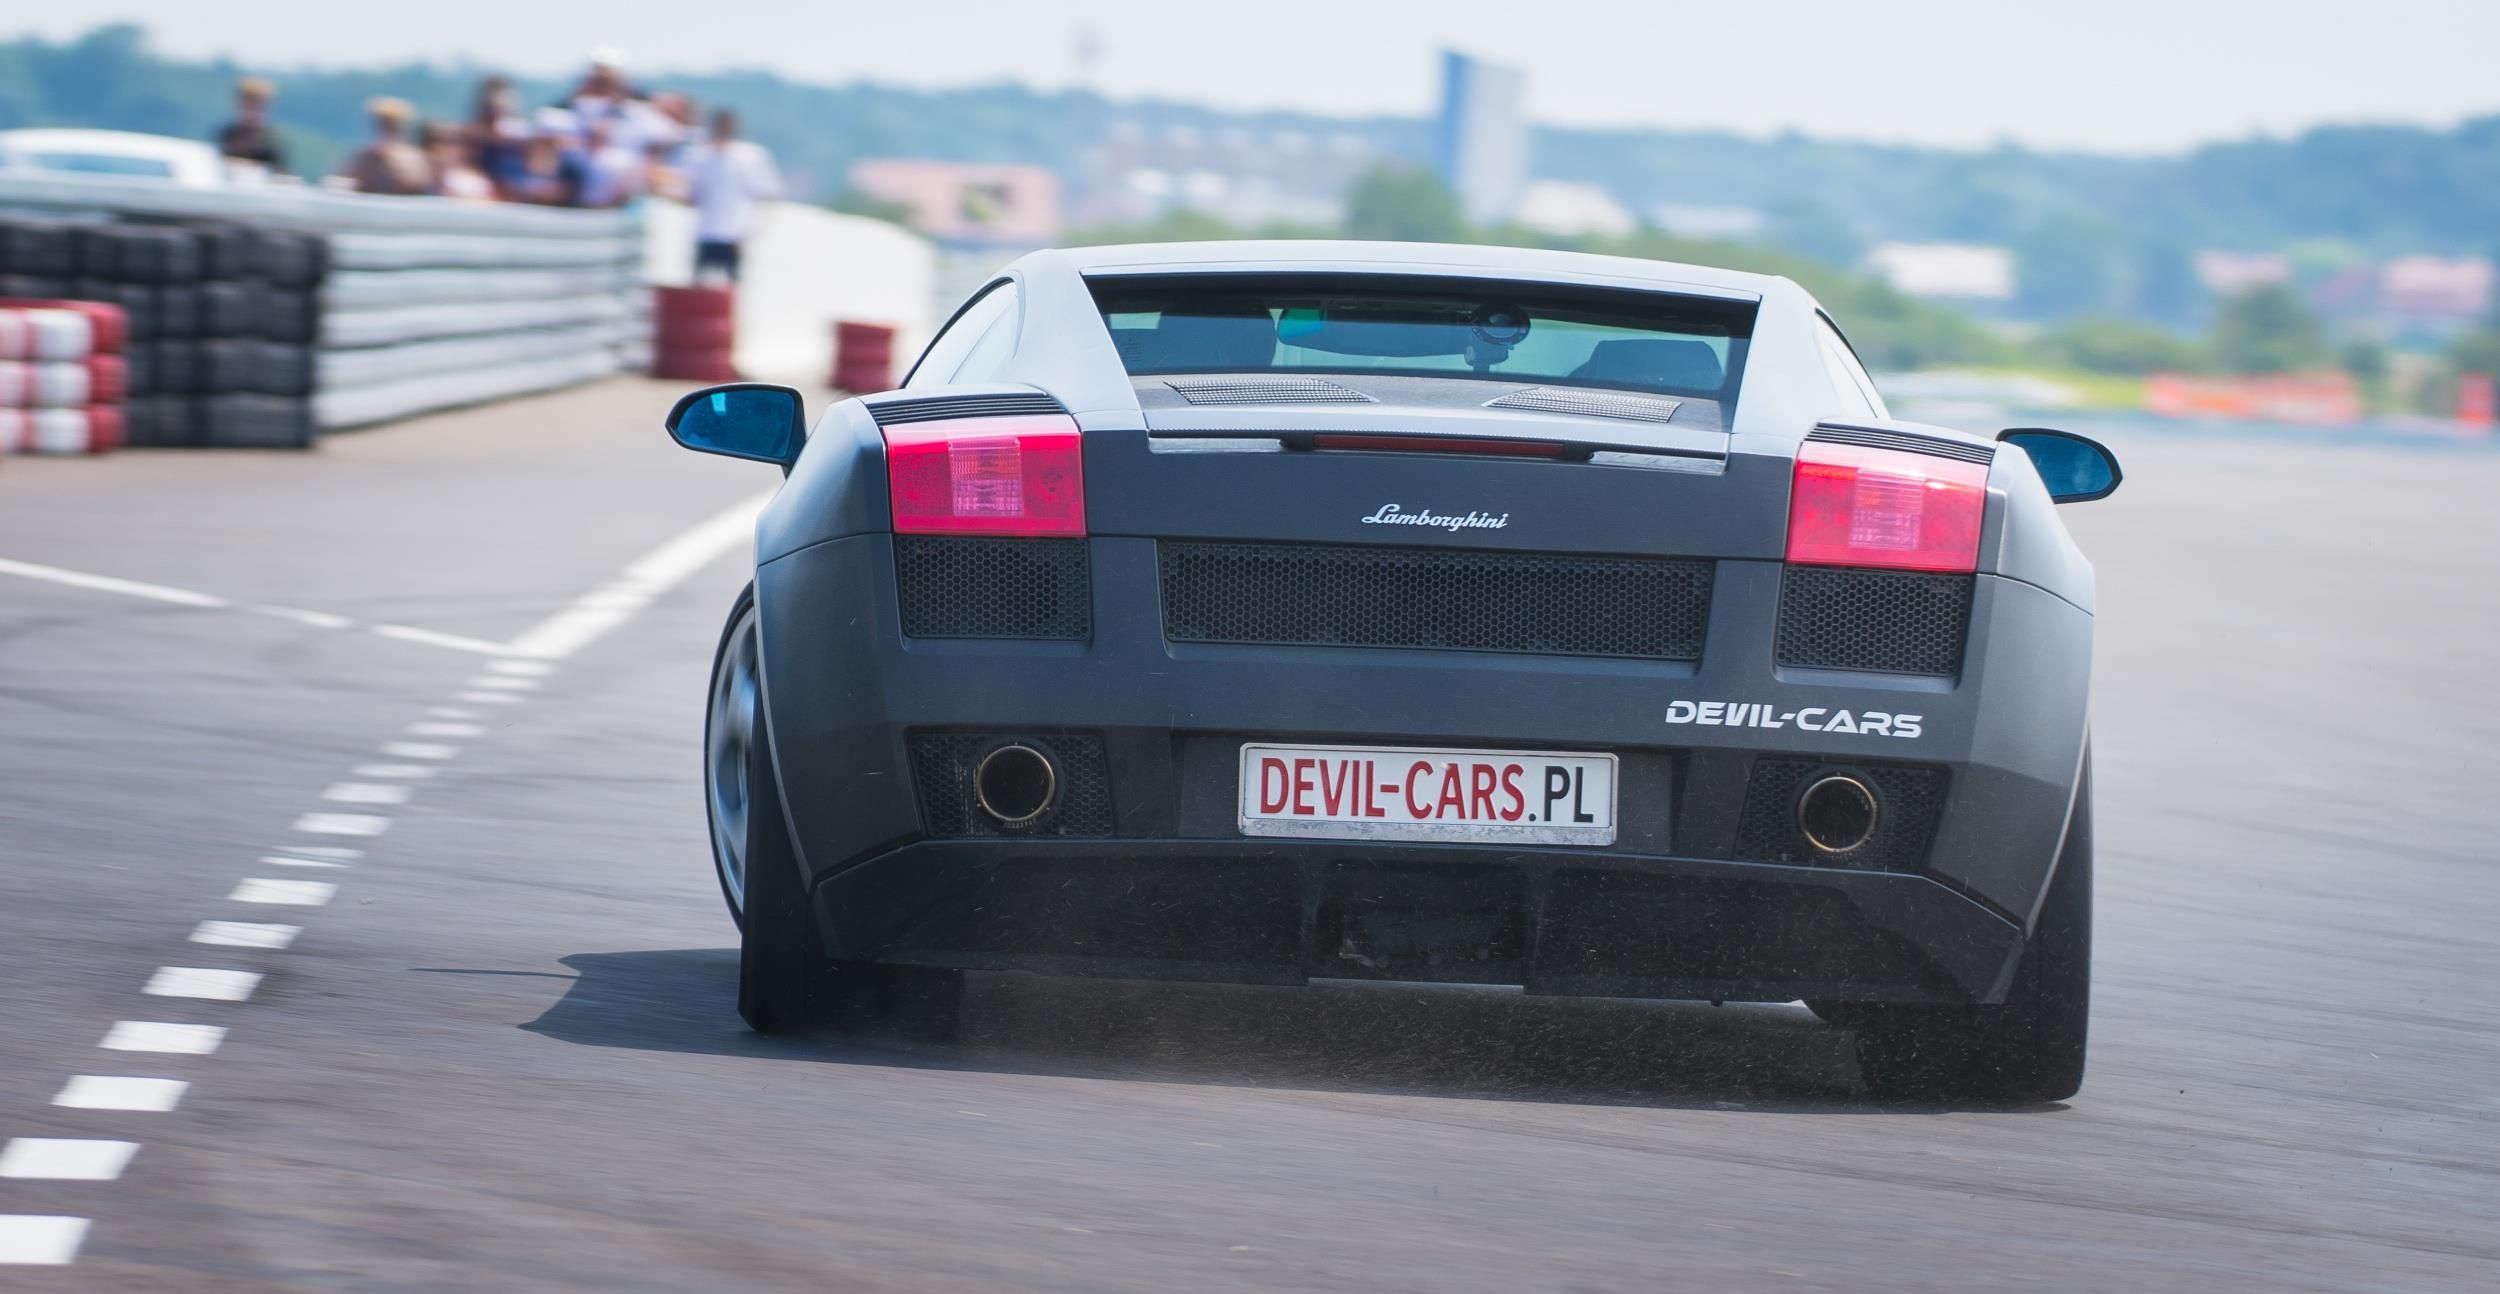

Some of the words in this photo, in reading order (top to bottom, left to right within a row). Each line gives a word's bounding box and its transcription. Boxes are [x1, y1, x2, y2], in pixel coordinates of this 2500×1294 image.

[1361, 503, 1509, 532] Lamborghini
[1665, 700, 1923, 738] DEVIL-CARS
[1260, 757, 1594, 823] DEVIL-CARS.PL
